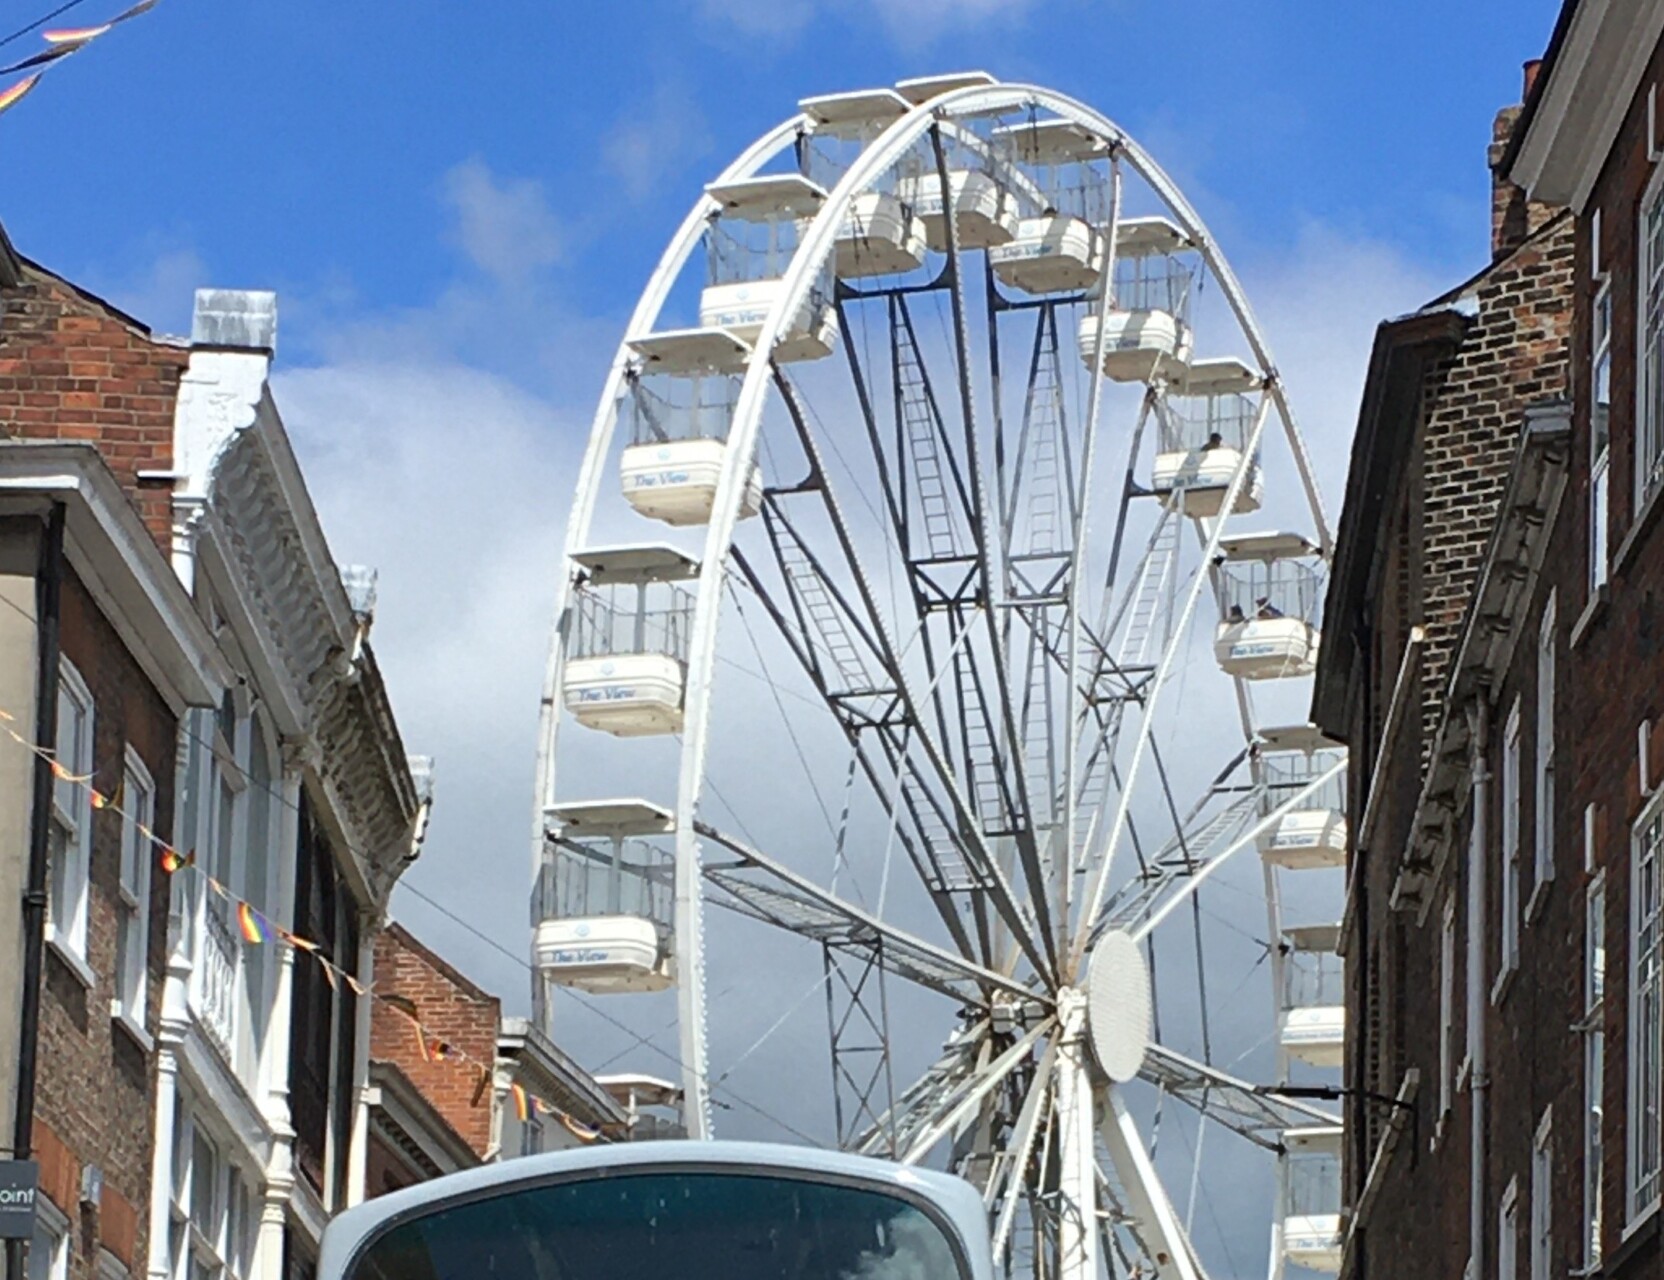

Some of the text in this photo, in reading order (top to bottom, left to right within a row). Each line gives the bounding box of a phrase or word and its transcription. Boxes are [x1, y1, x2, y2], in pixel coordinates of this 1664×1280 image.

[578, 685, 636, 702] The View
[552, 949, 609, 963] The View
